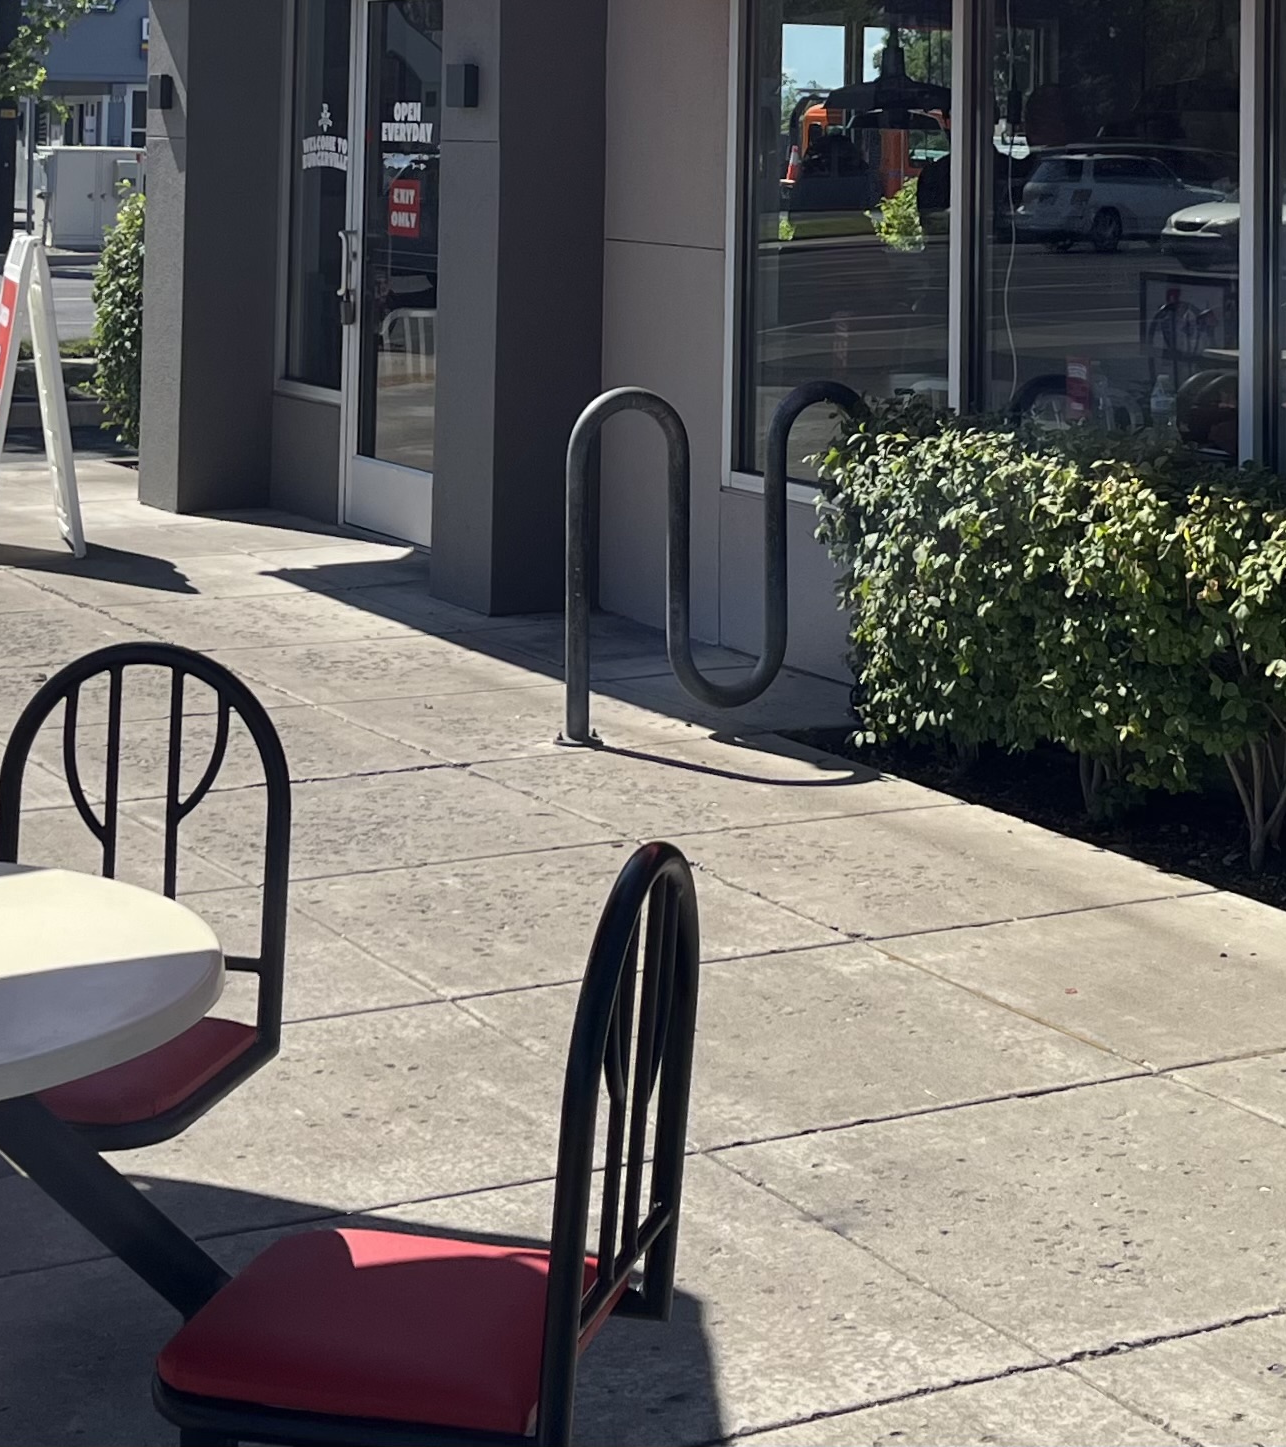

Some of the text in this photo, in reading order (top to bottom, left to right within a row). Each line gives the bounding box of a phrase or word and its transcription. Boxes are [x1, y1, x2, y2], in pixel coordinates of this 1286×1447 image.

[394, 102, 421, 121] OPEN
[382, 122, 433, 143] EVERYDAY
[302, 135, 348, 154] WELCOME TO
[393, 188, 415, 205] EXIT
[390, 211, 416, 228] ONLY
